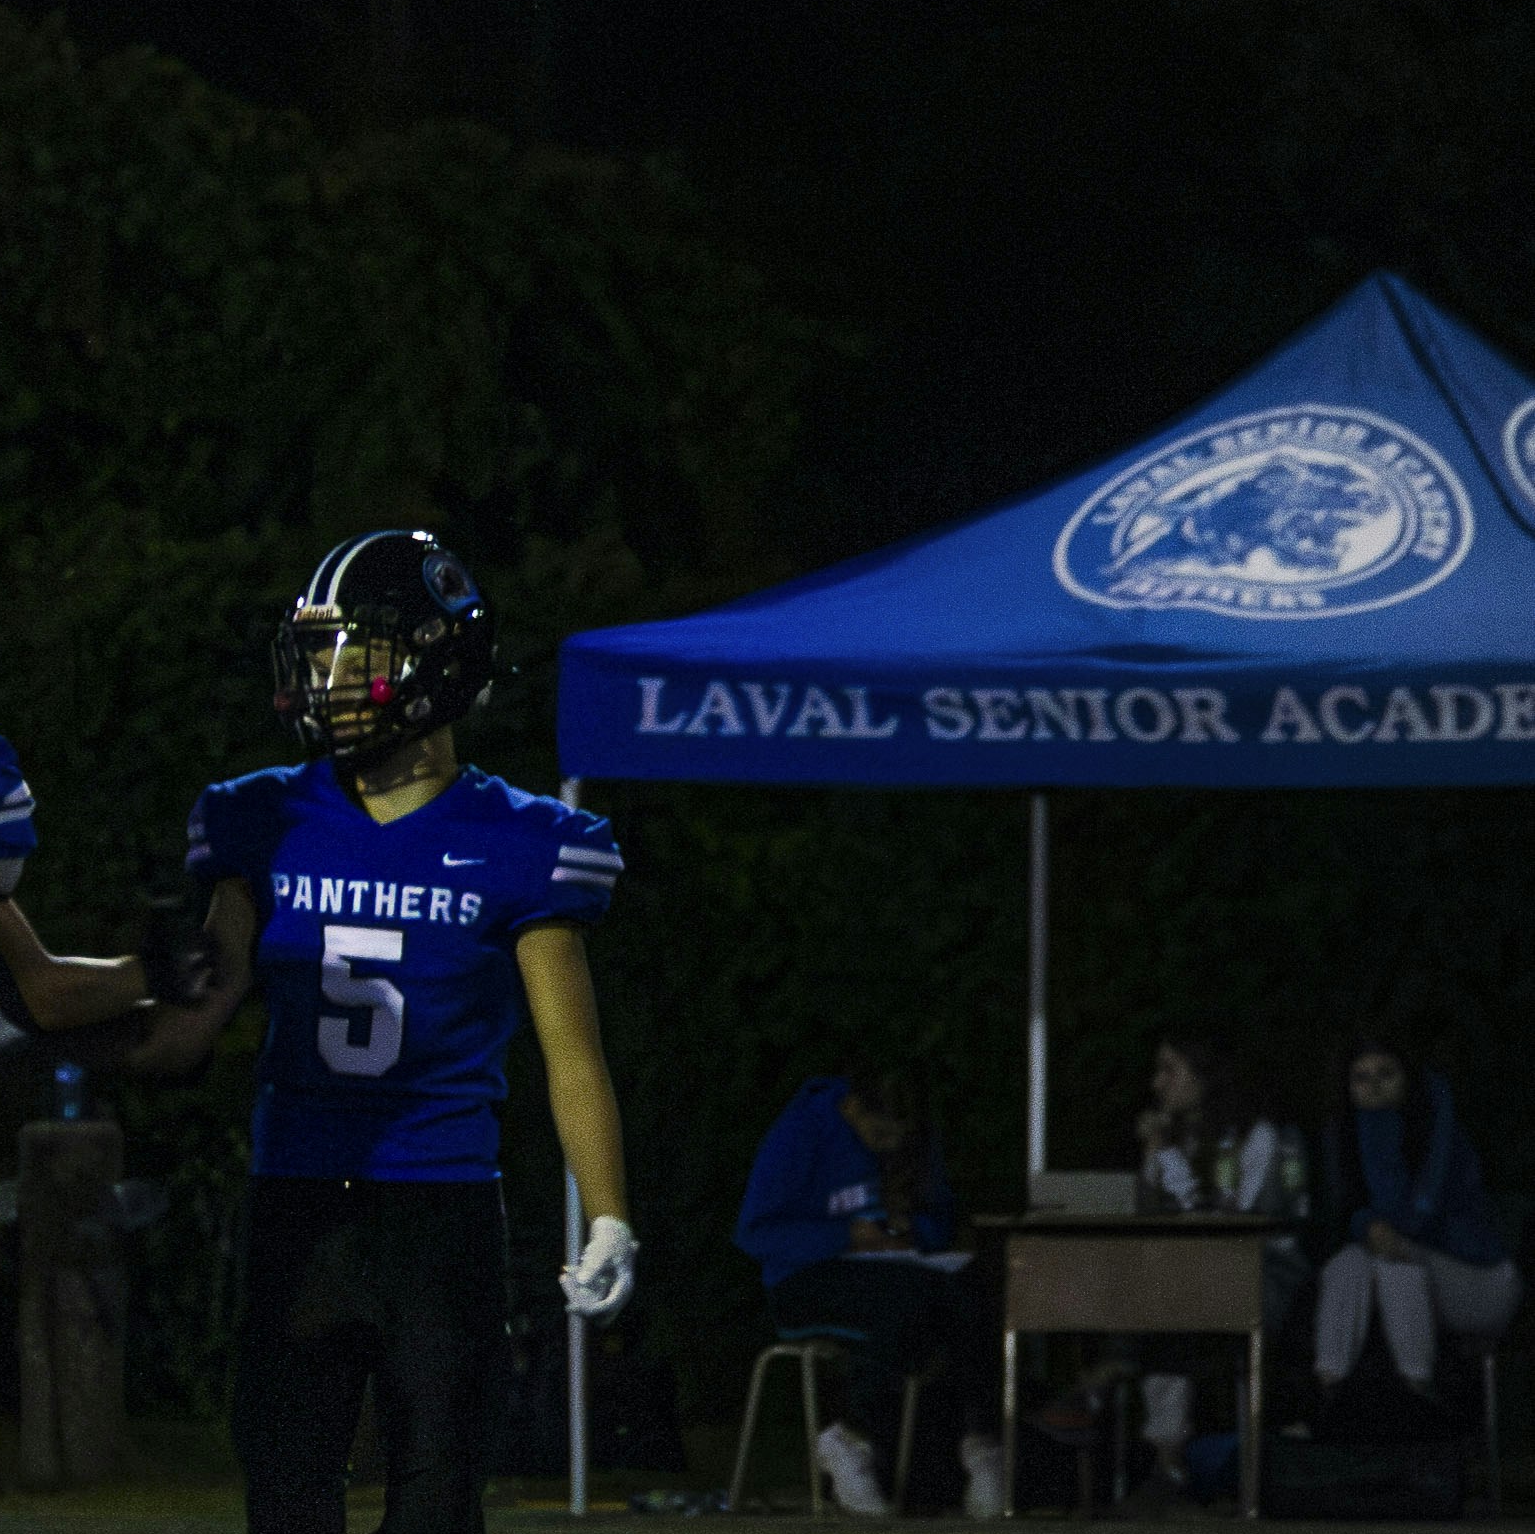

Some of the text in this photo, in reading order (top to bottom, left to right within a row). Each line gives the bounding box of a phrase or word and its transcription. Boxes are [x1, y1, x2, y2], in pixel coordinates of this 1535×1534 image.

[635, 676, 899, 739] LAVAL
[922, 685, 1242, 743] SENIOR
[271, 872, 483, 926] PANTHERS
[316, 924, 406, 1078] 5
